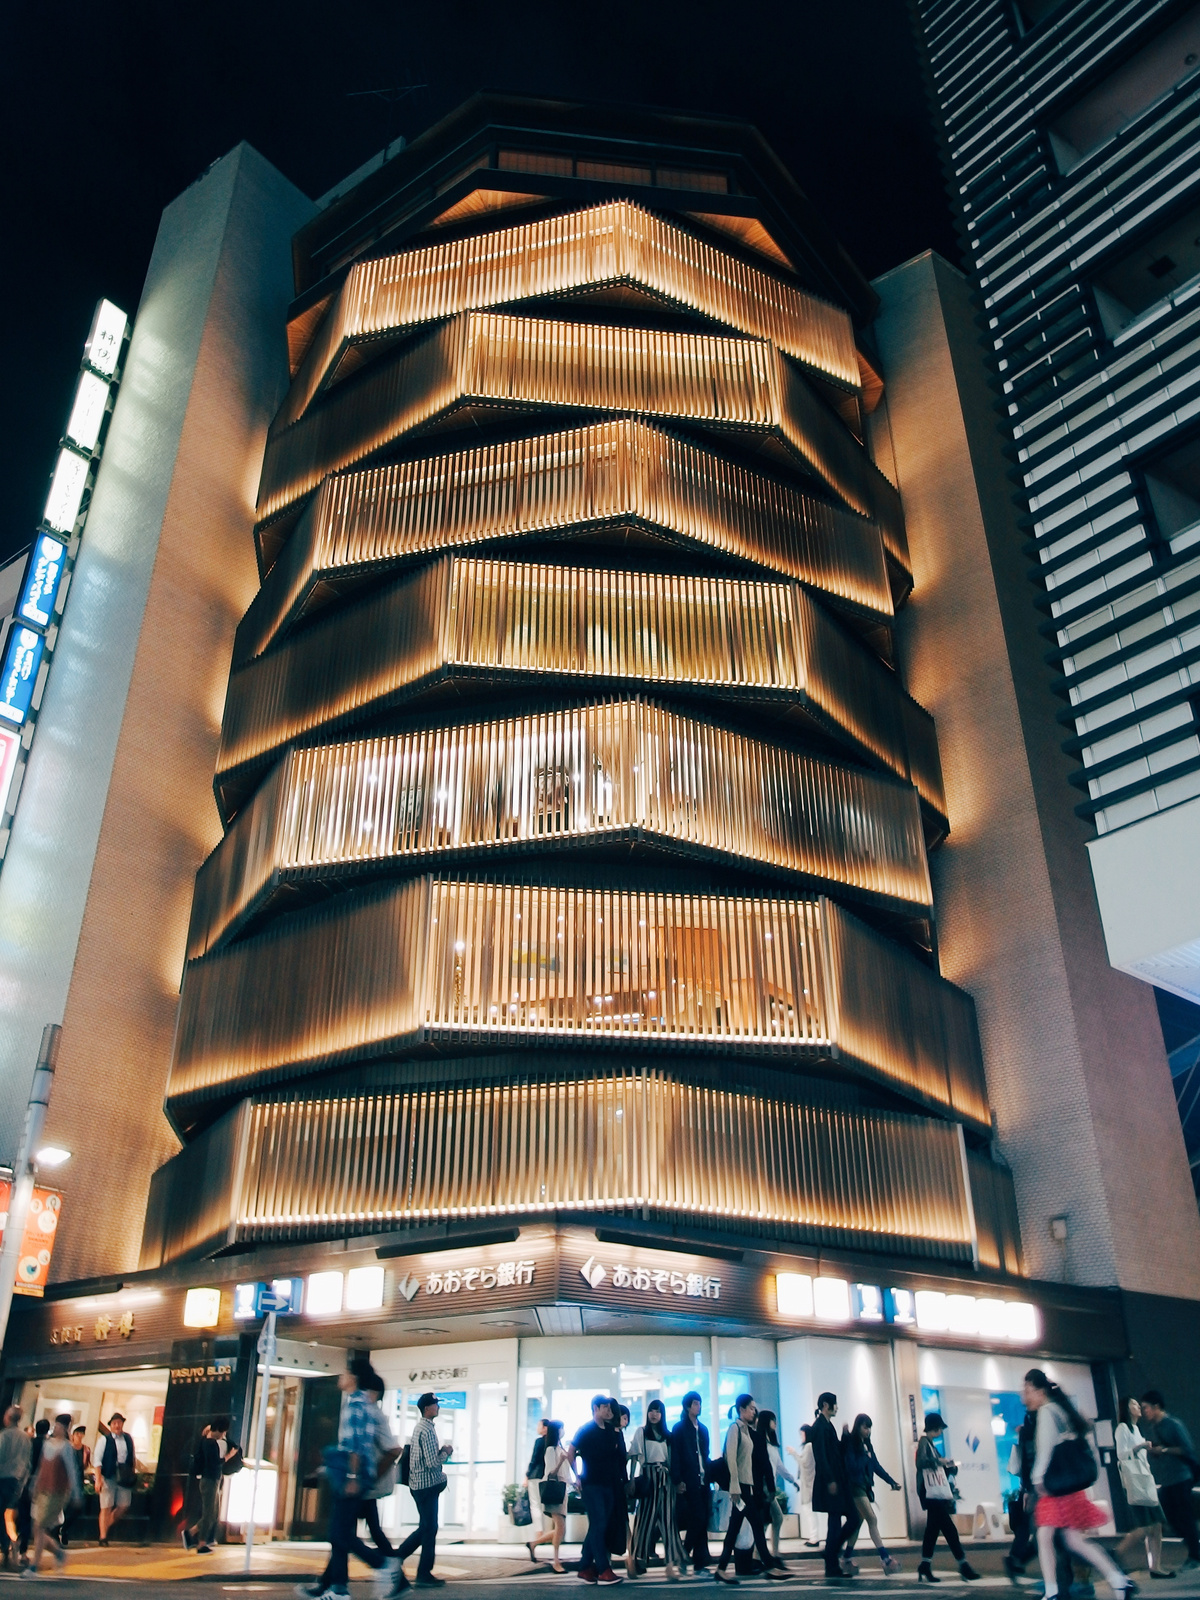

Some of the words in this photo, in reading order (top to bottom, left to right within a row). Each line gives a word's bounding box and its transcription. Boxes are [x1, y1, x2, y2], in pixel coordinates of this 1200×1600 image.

[425, 1260, 535, 1295] あおぞら銀行
[612, 1264, 722, 1299] あおぞら銀行
[170, 1366, 205, 1379] YASUYO
[207, 1365, 231, 1376] BLDG
